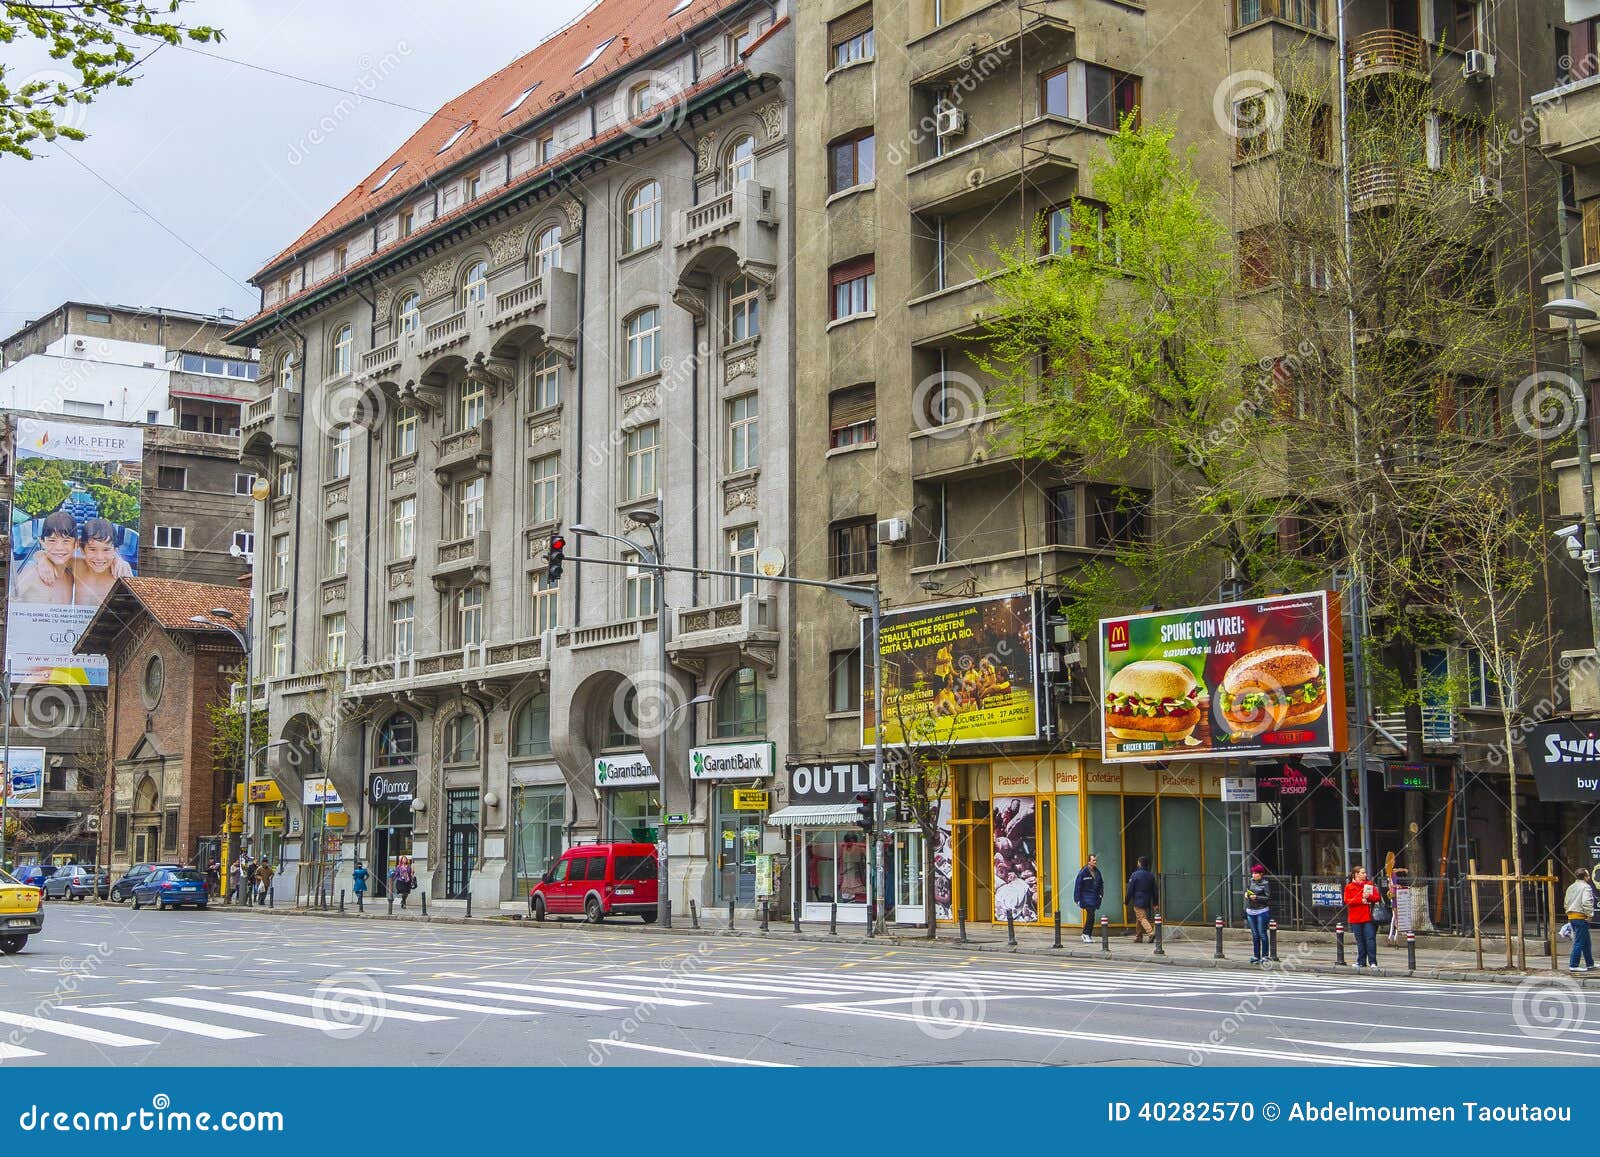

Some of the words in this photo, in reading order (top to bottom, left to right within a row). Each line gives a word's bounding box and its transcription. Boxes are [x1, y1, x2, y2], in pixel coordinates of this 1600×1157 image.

[91, 438, 125, 449] PETER
[933, 619, 965, 633] PRIETENI
[1161, 622, 1192, 642] SPUNE
[1194, 619, 1215, 639] CUM
[1217, 616, 1245, 635] VREI:
[947, 631, 957, 641] LA
[959, 627, 974, 639] RIO.
[1163, 645, 1202, 658] savuros
[704, 751, 762, 771] GarantiBank
[607, 762, 654, 779] GarantiBan
[998, 774, 1030, 786] Patiserie
[1056, 772, 1078, 783] Pâine
[1577, 777, 1599, 790] buy
